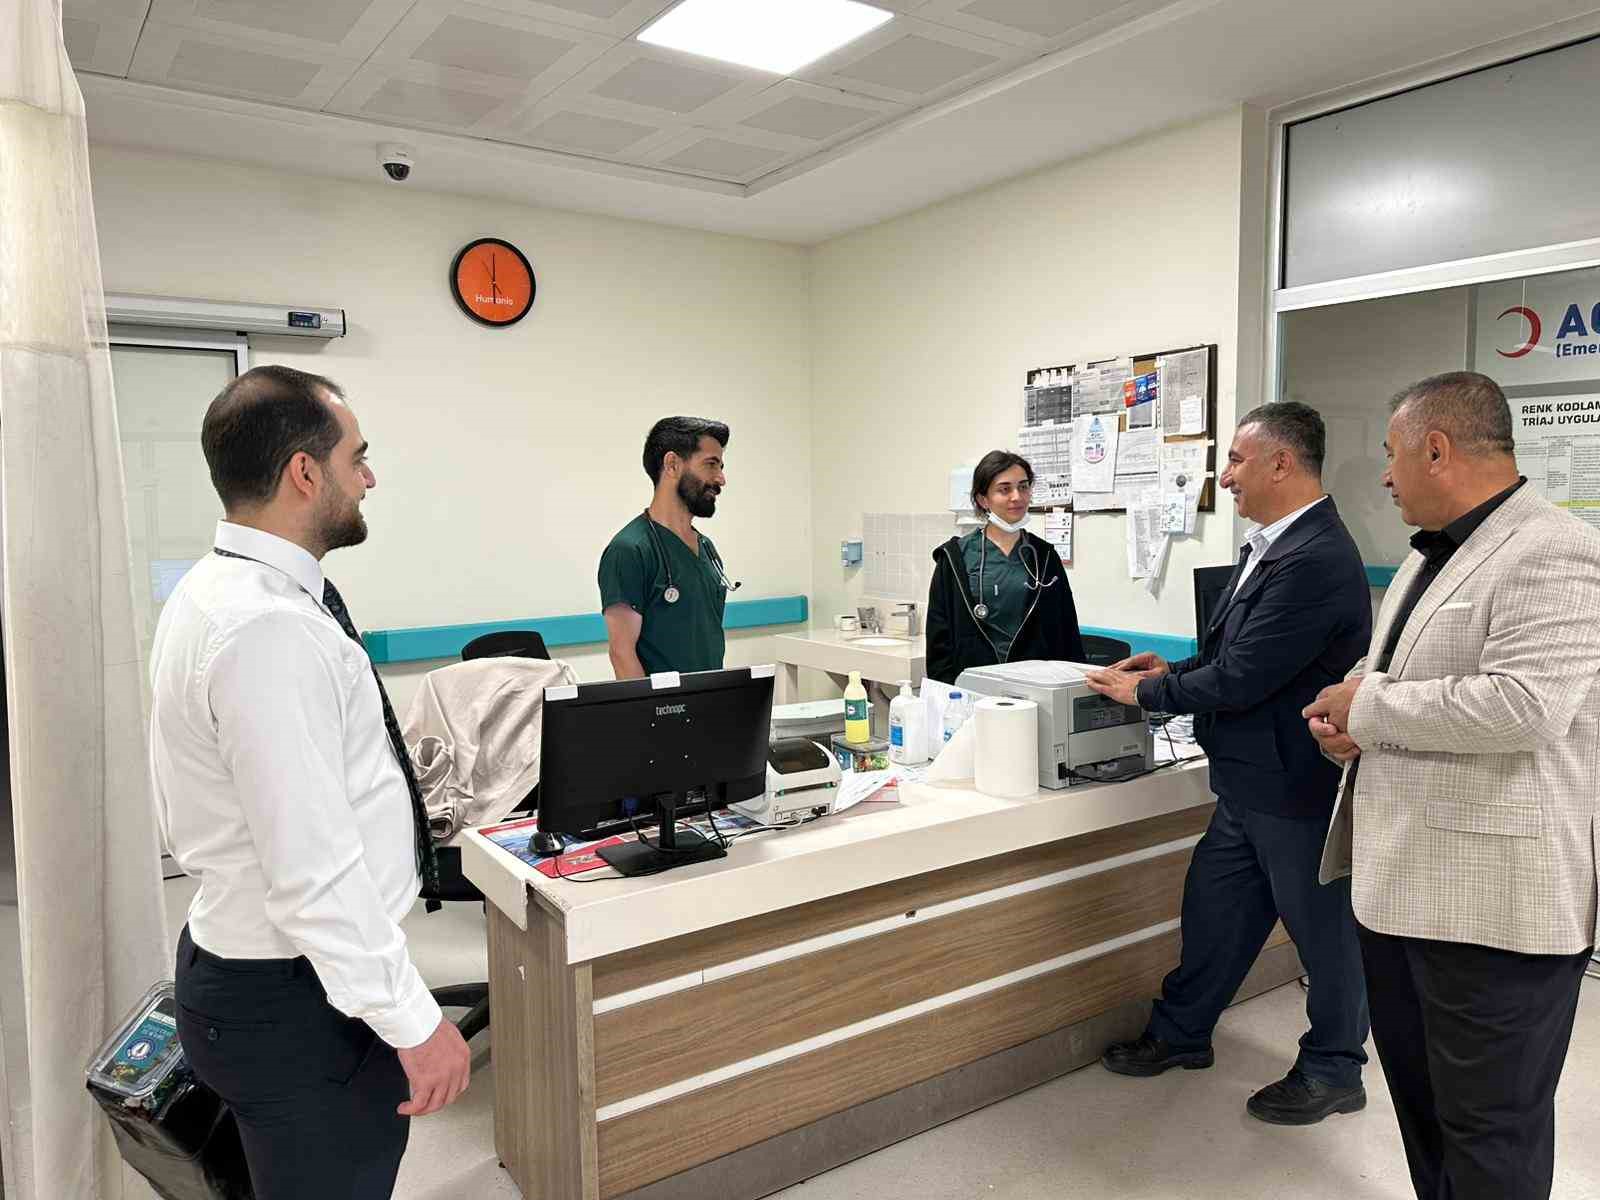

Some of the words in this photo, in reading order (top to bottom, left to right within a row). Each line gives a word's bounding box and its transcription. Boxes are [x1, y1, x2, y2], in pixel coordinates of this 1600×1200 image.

[1556, 342, 1600, 358] (Eme
[1522, 404, 1552, 414] RENK
[1522, 415, 1553, 426] TRİAJ
